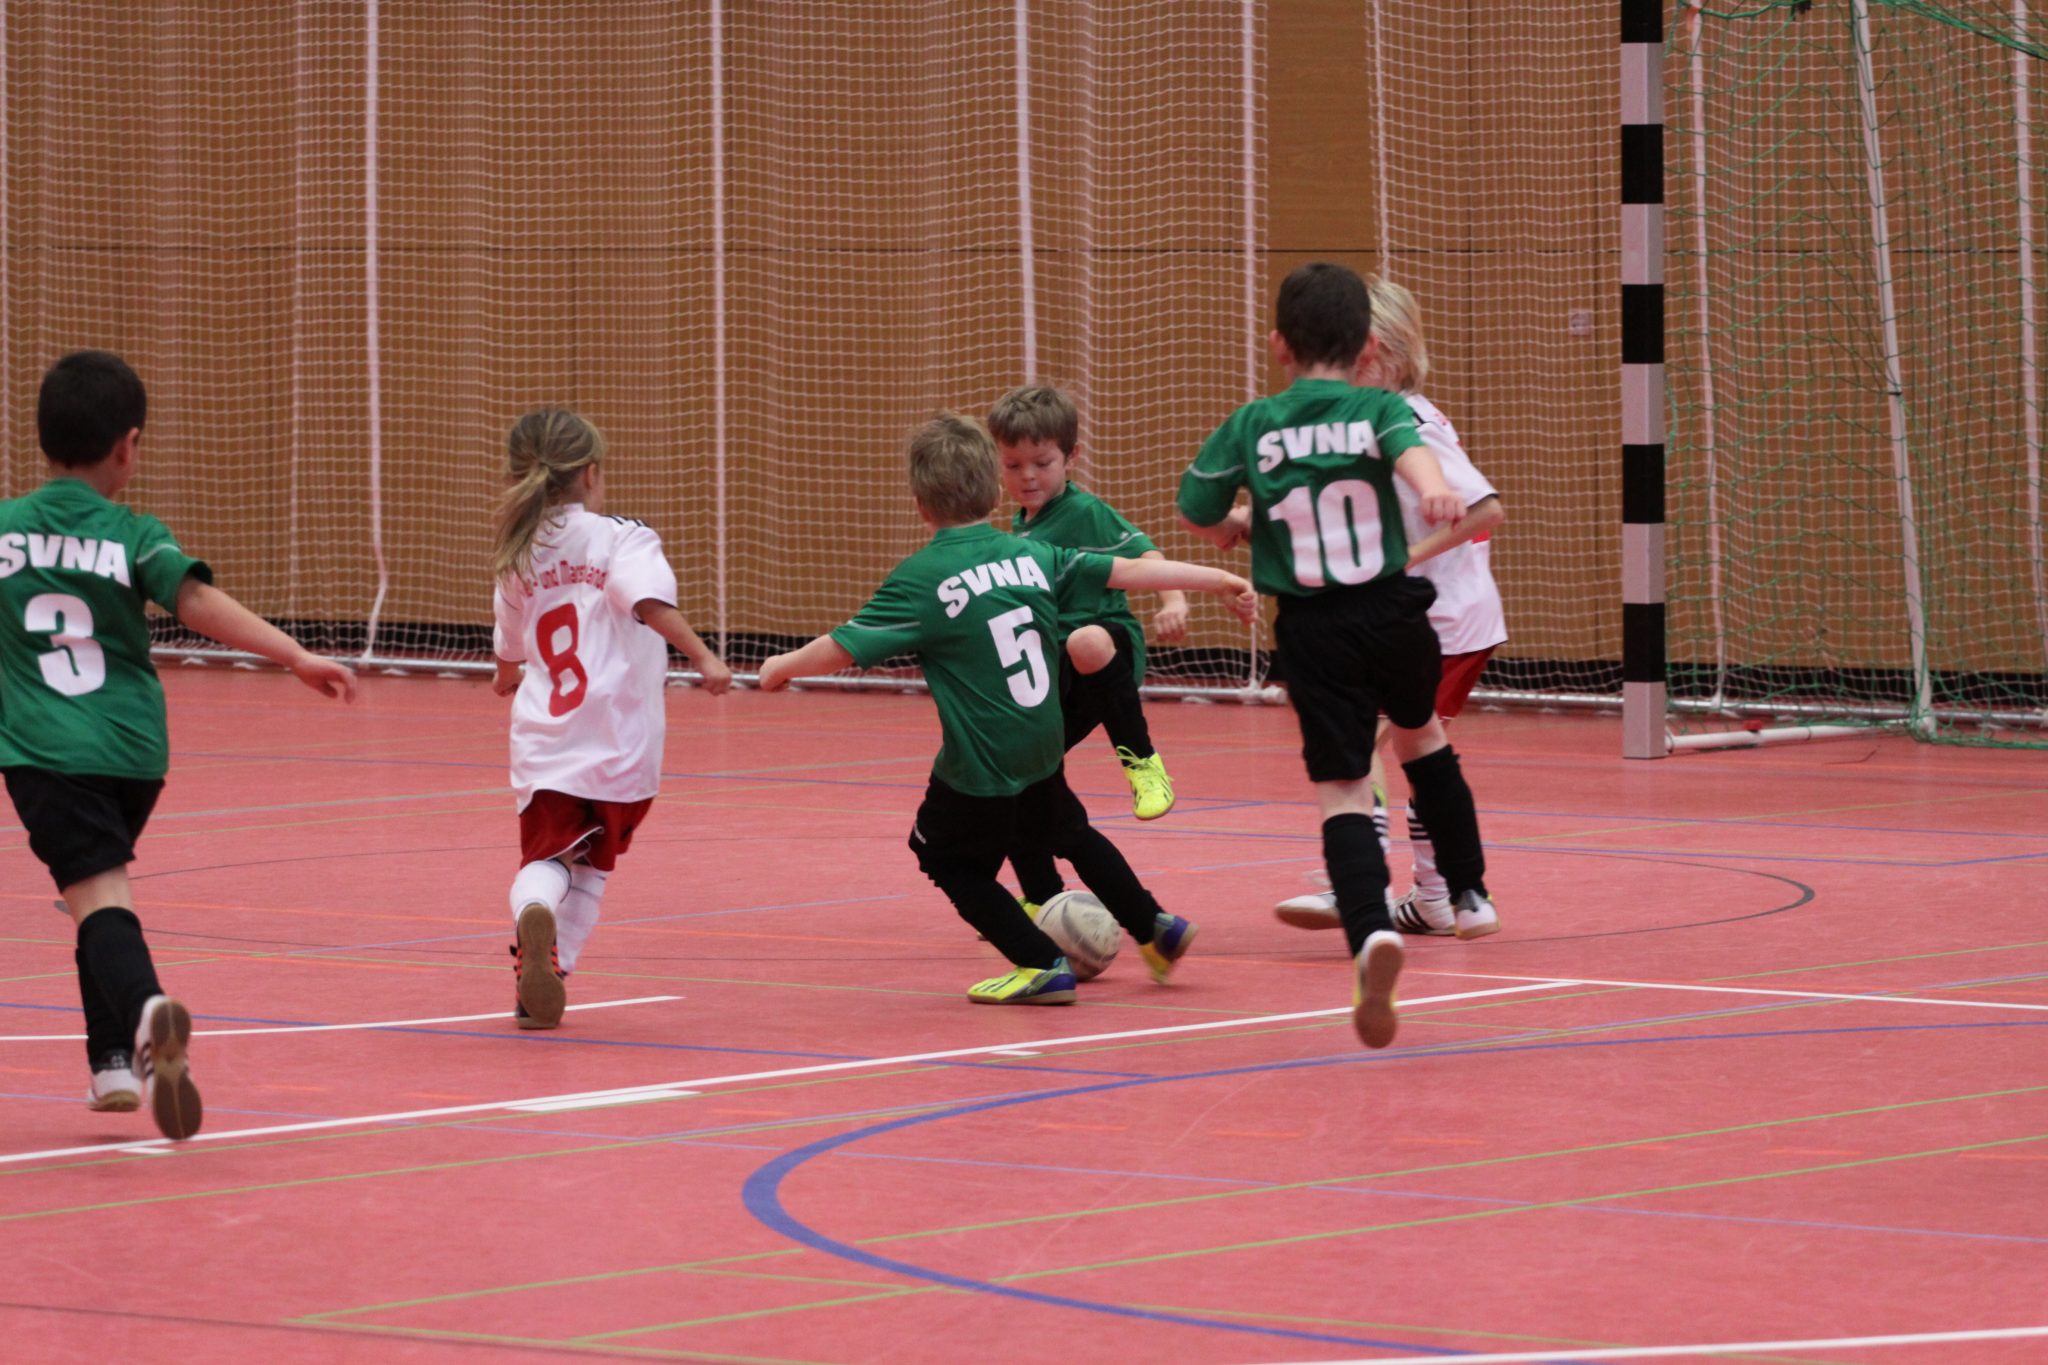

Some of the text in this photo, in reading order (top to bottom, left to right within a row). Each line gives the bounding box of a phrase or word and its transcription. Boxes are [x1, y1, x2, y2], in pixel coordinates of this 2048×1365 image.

[1257, 420, 1381, 474] SVNA
[0, 532, 132, 588] SVNA
[1268, 479, 1385, 588] 10
[937, 556, 1050, 618] SVNA
[25, 593, 106, 696] 3
[536, 603, 588, 717] 8
[987, 605, 1050, 707] 5
